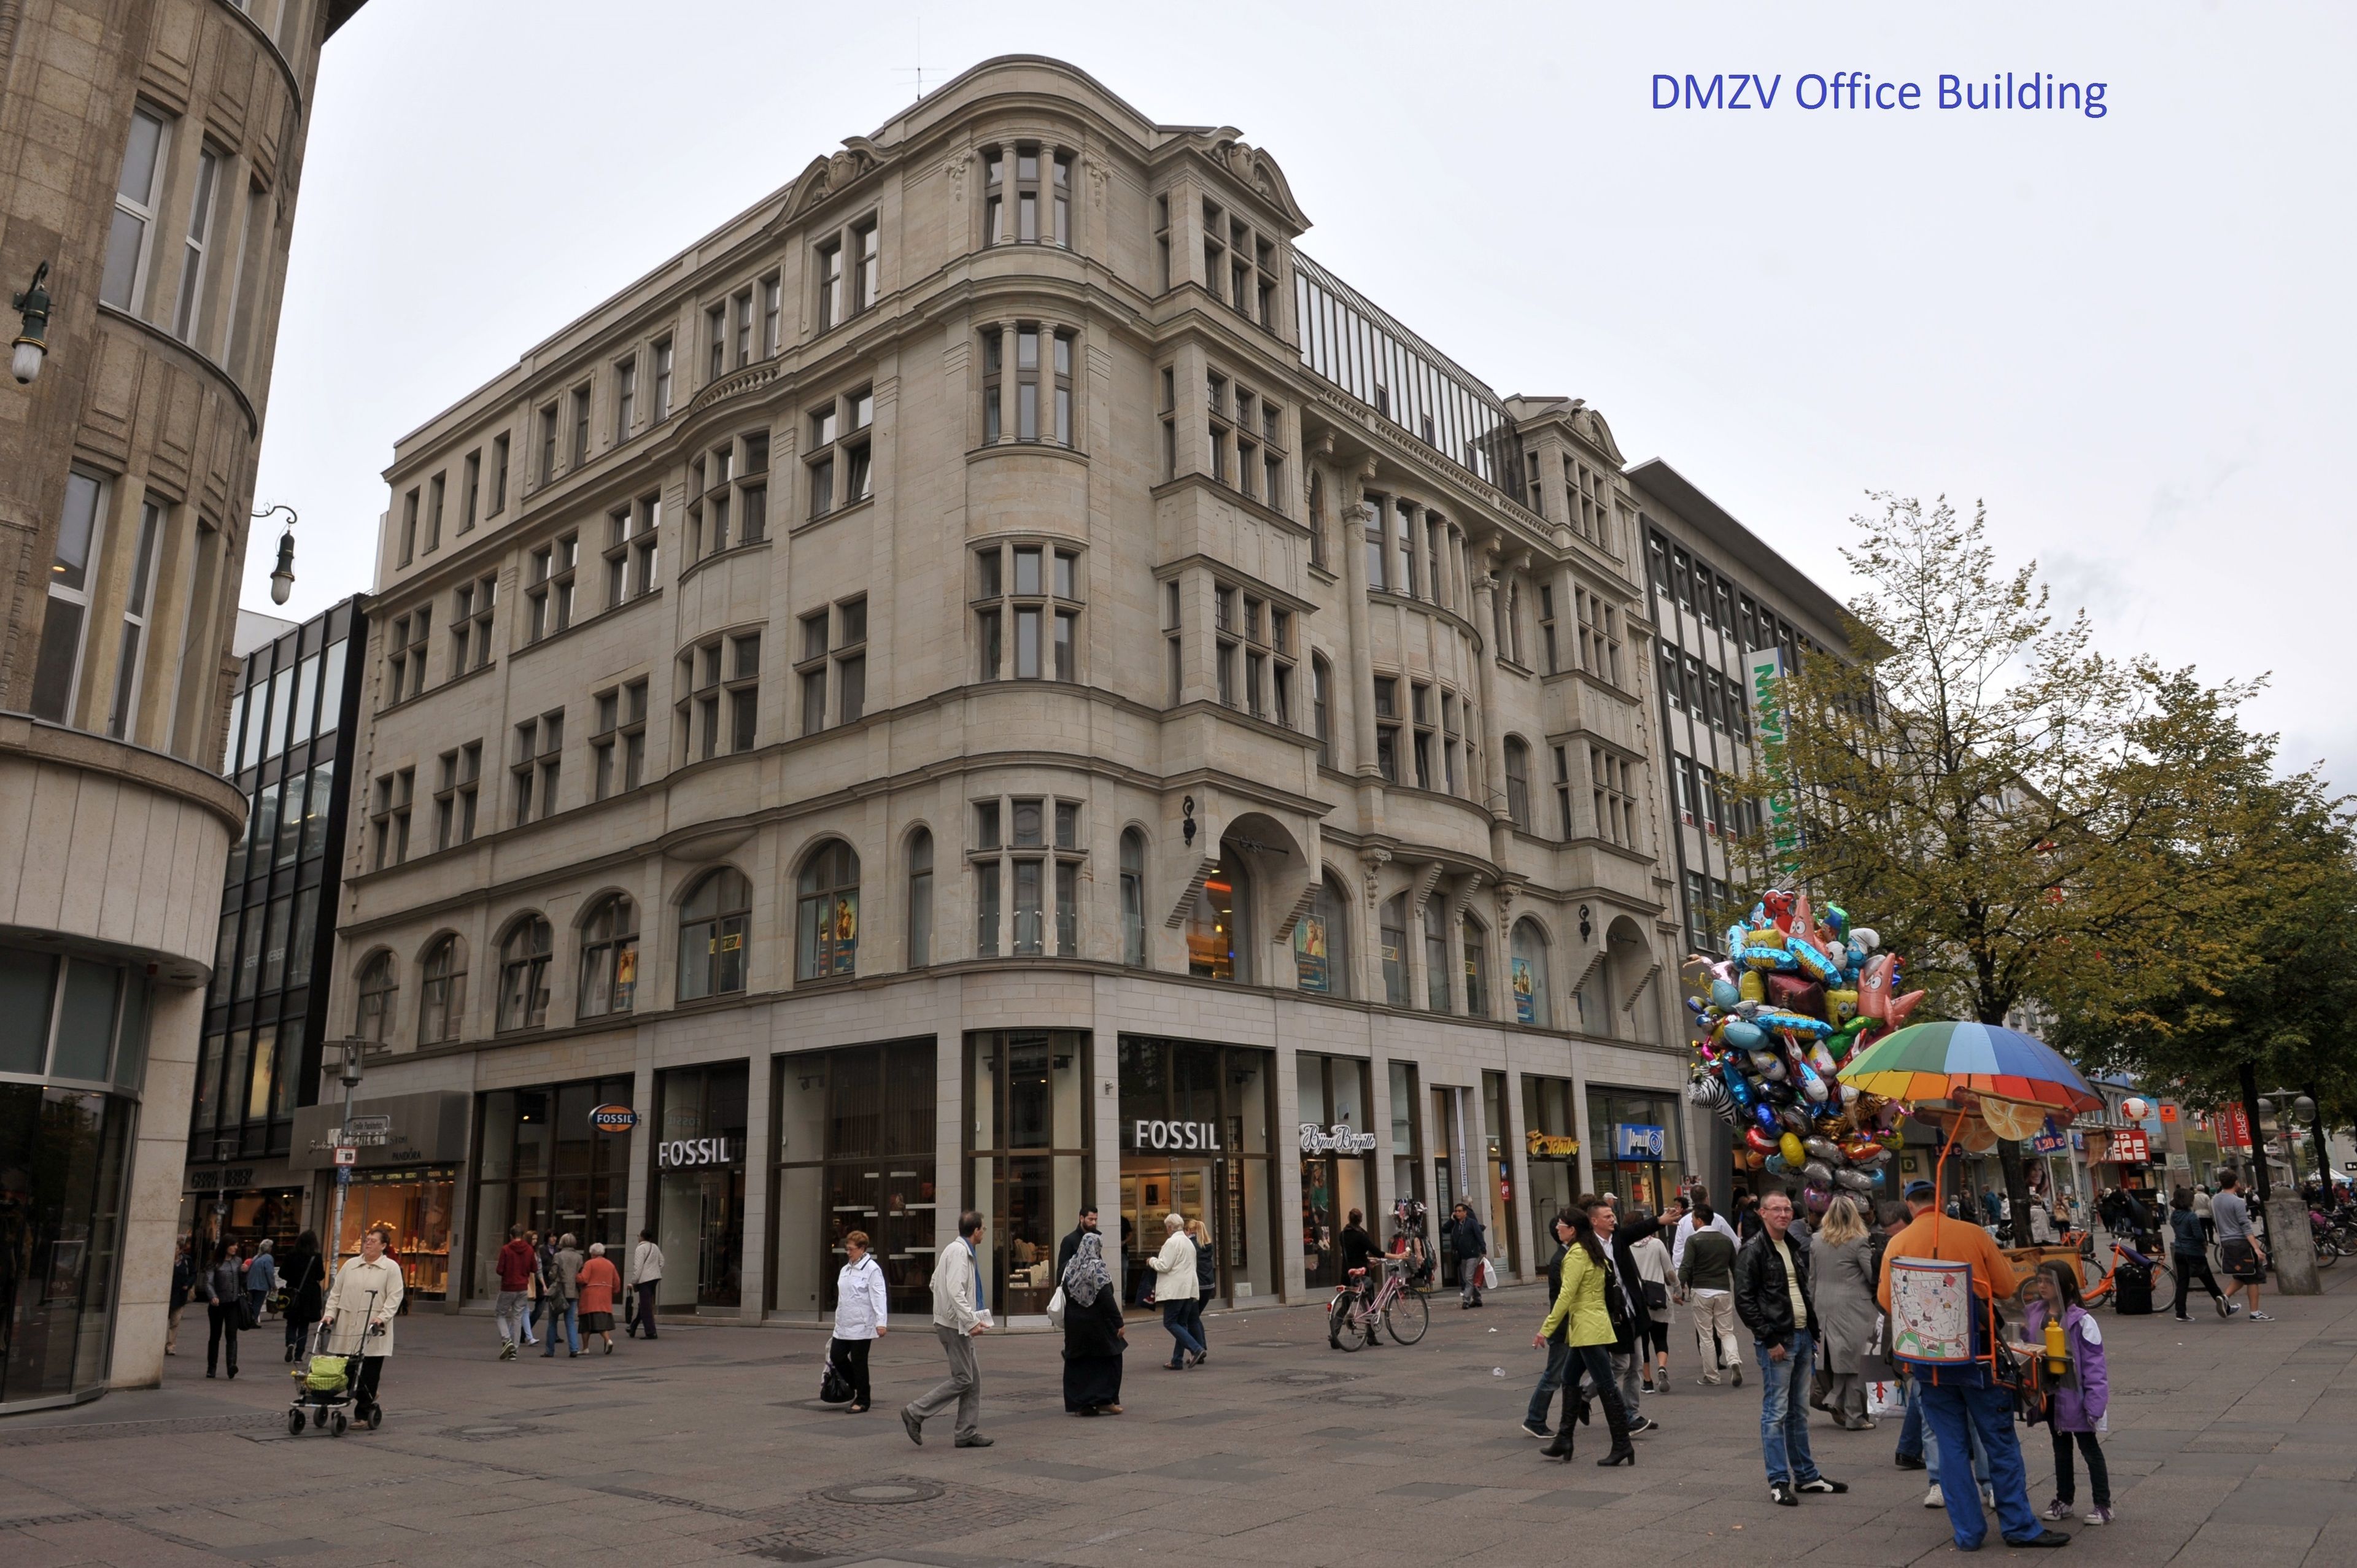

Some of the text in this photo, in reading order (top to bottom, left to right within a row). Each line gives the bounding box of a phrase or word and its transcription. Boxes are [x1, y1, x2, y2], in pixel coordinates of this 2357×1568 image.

[597, 1114, 633, 1123] FOSSIL
[1136, 1120, 1220, 1150] FOSSIL
[1302, 1124, 1335, 1153] Bijou
[1546, 1137, 1581, 1155] Tchibo
[2035, 1138, 2056, 1152] 1,20
[659, 1137, 730, 1166] FOSSIL
